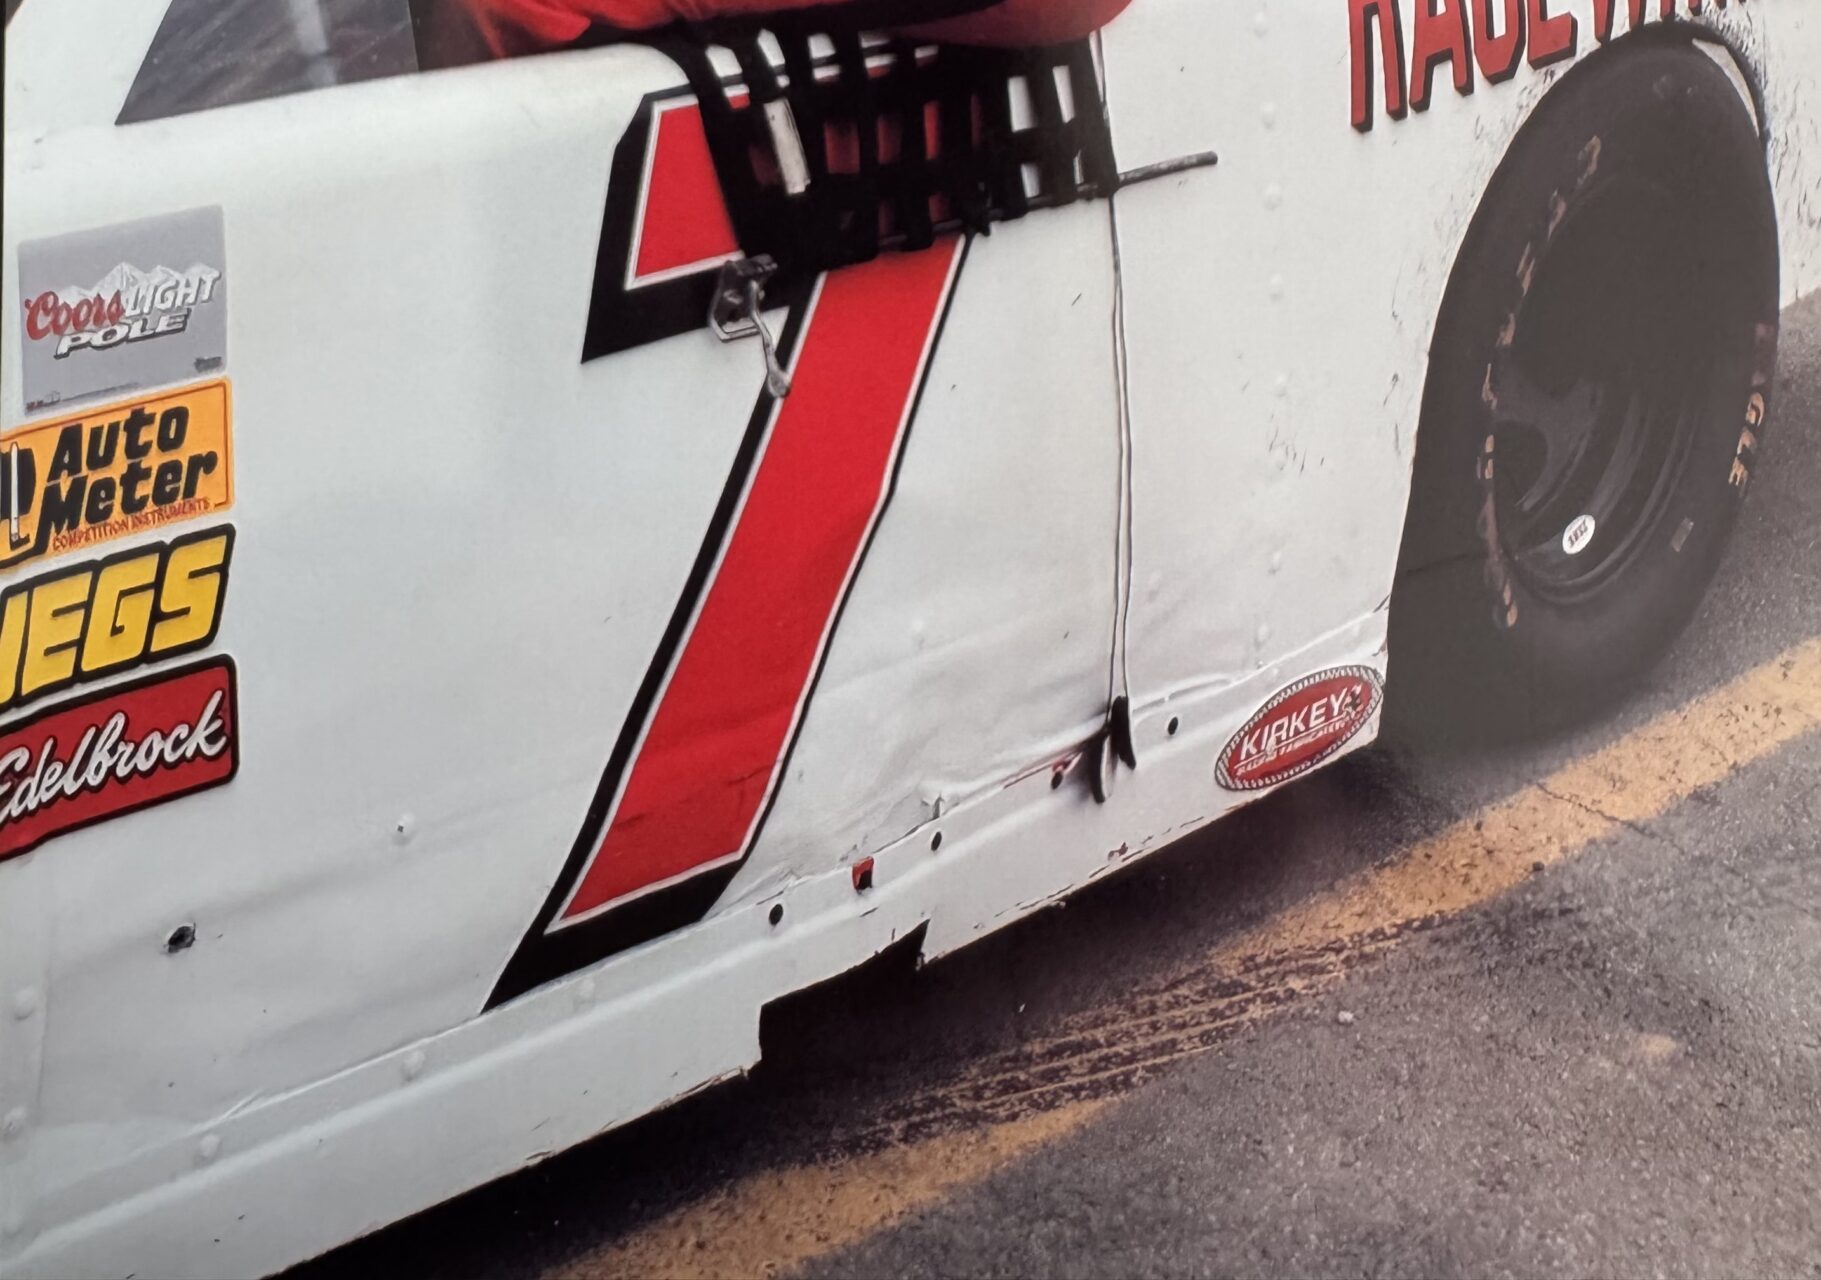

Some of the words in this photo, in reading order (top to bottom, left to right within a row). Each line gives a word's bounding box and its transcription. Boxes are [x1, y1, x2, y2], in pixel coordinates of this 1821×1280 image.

[24, 289, 127, 341] Coors
[124, 269, 222, 317] LIGHT
[53, 308, 192, 360] POLE
[47, 405, 190, 483] Auto
[37, 450, 218, 552] Meter
[481, 40, 990, 1016] 7
[0, 530, 231, 707] JEGS
[0, 689, 228, 826] Edelbrock
[1240, 687, 1348, 761] KIRKEY
